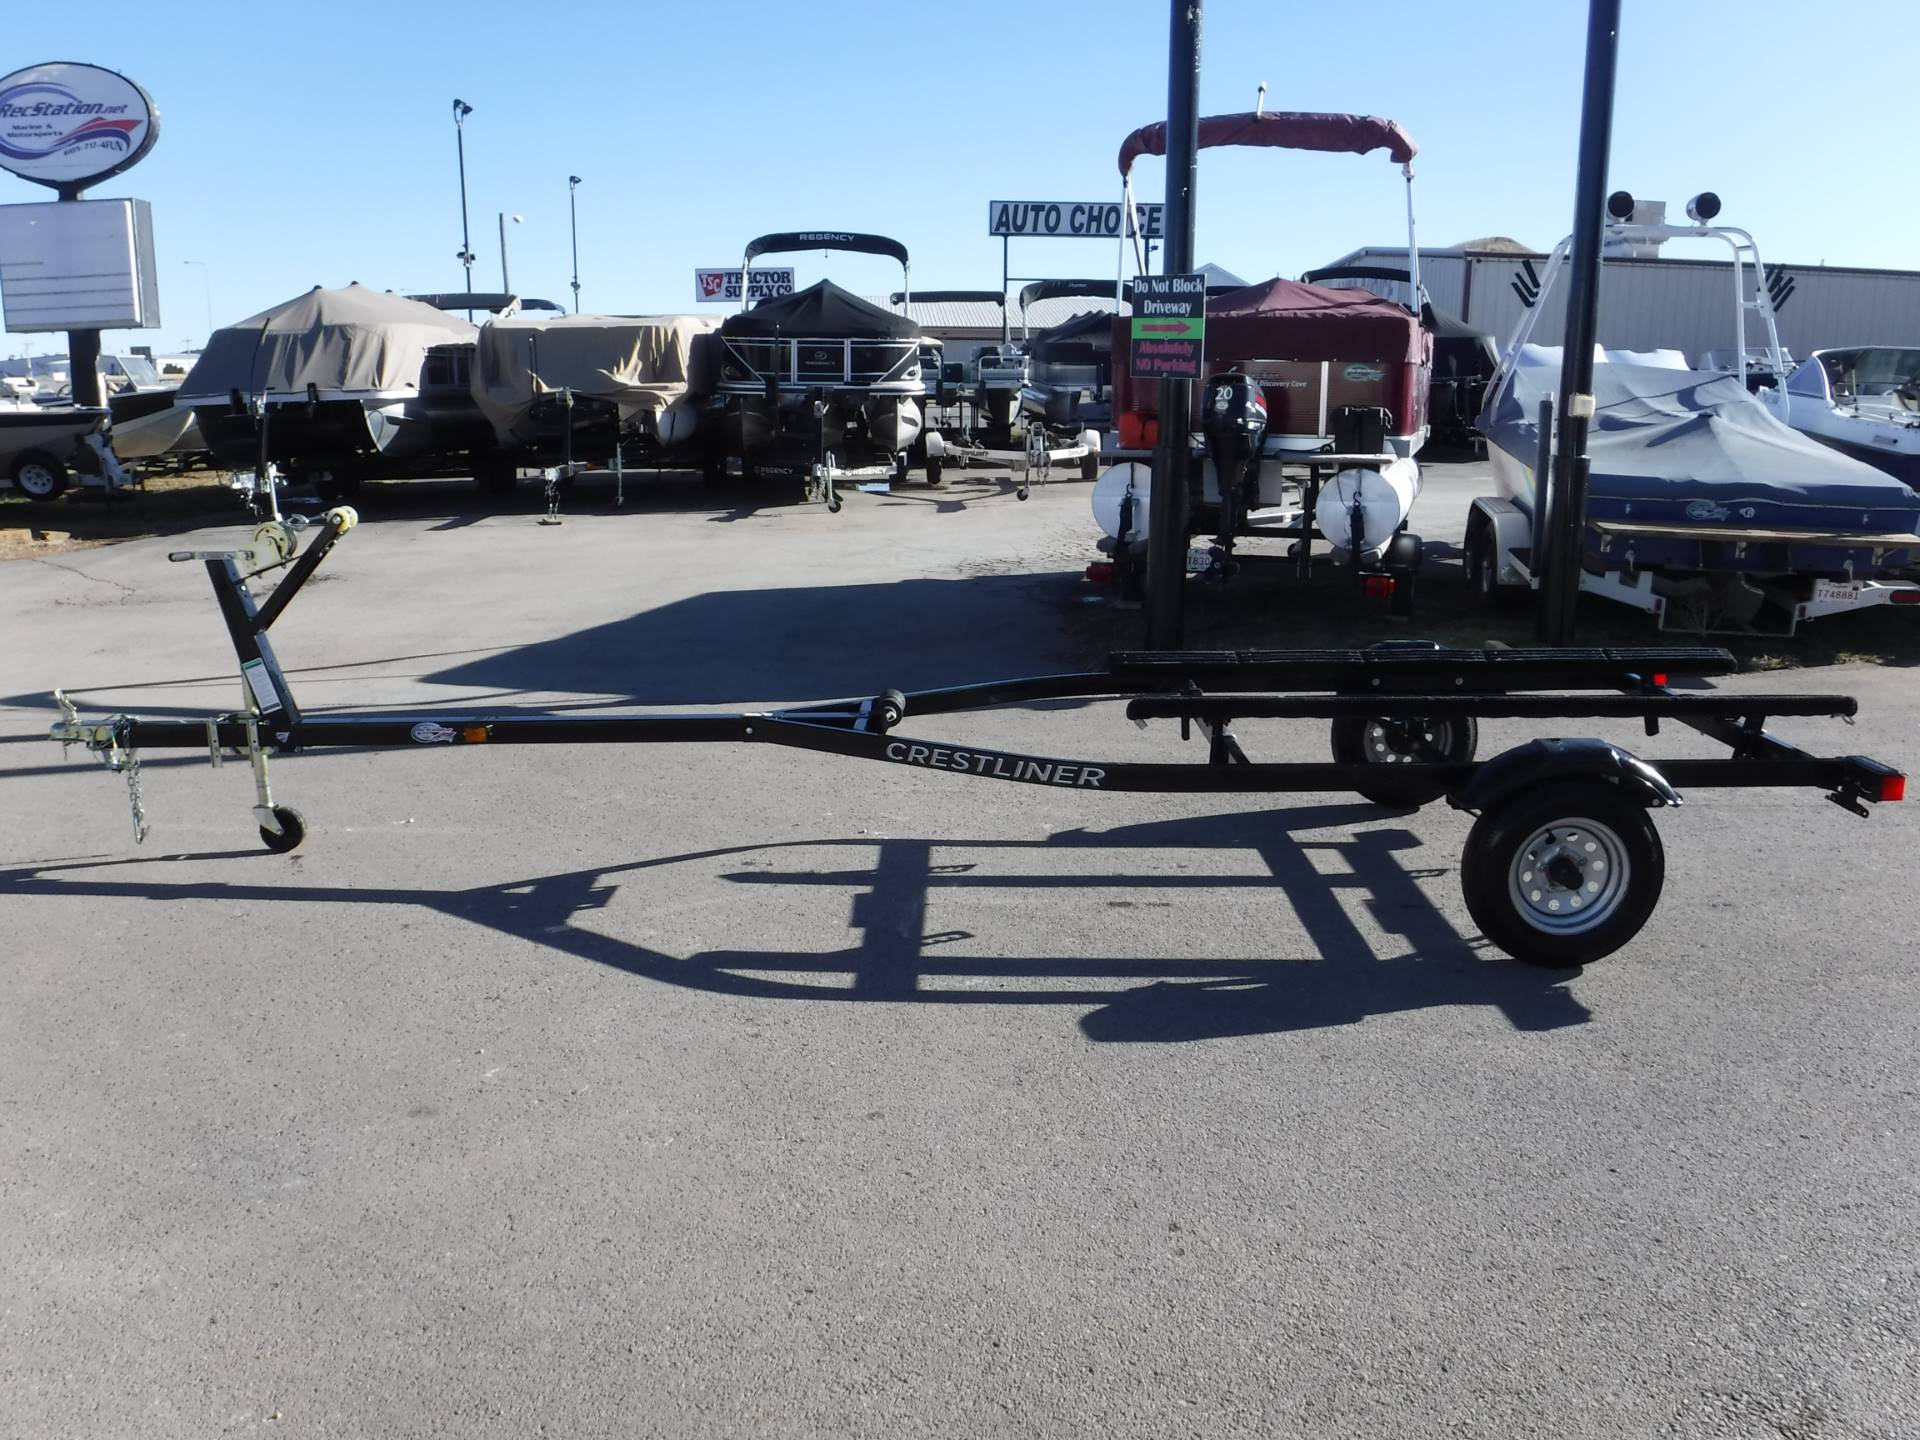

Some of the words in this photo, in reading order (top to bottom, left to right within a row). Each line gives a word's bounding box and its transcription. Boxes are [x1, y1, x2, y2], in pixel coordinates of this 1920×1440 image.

[994, 203, 1061, 233] AUTO
[1069, 204, 1163, 235] CHOCE
[799, 233, 855, 241] REGENCY
[702, 274, 721, 292] TSC
[1134, 279, 1149, 293] Do
[1151, 279, 1170, 293] Not
[1172, 278, 1204, 293] Block
[725, 285, 774, 298] SUPLY
[1143, 299, 1193, 317] Driveway
[1140, 341, 1194, 357] Absolutely
[1153, 358, 1197, 375] Parking
[1260, 380, 1289, 388] Discovery
[1215, 387, 1233, 400] 20
[760, 466, 793, 475] REGENCY
[852, 467, 887, 476] REGENCY
[886, 742, 1106, 787] CRESTLINER
